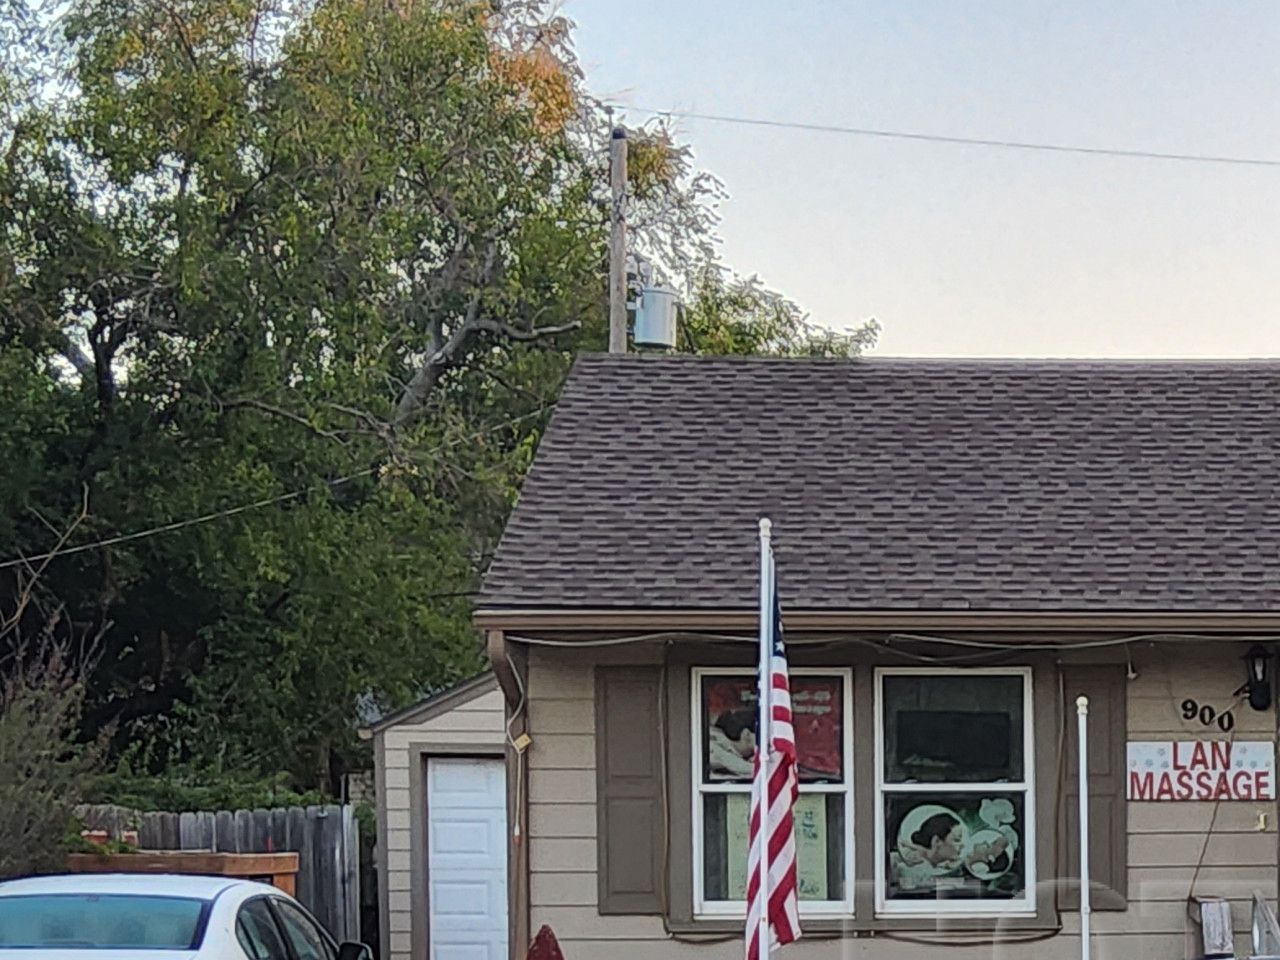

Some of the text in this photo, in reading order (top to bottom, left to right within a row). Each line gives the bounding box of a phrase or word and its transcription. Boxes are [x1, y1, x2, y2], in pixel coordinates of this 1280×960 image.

[1181, 698, 1235, 732] 900
[1172, 741, 1232, 770] LAN
[1130, 771, 1270, 800] MASSAGE
